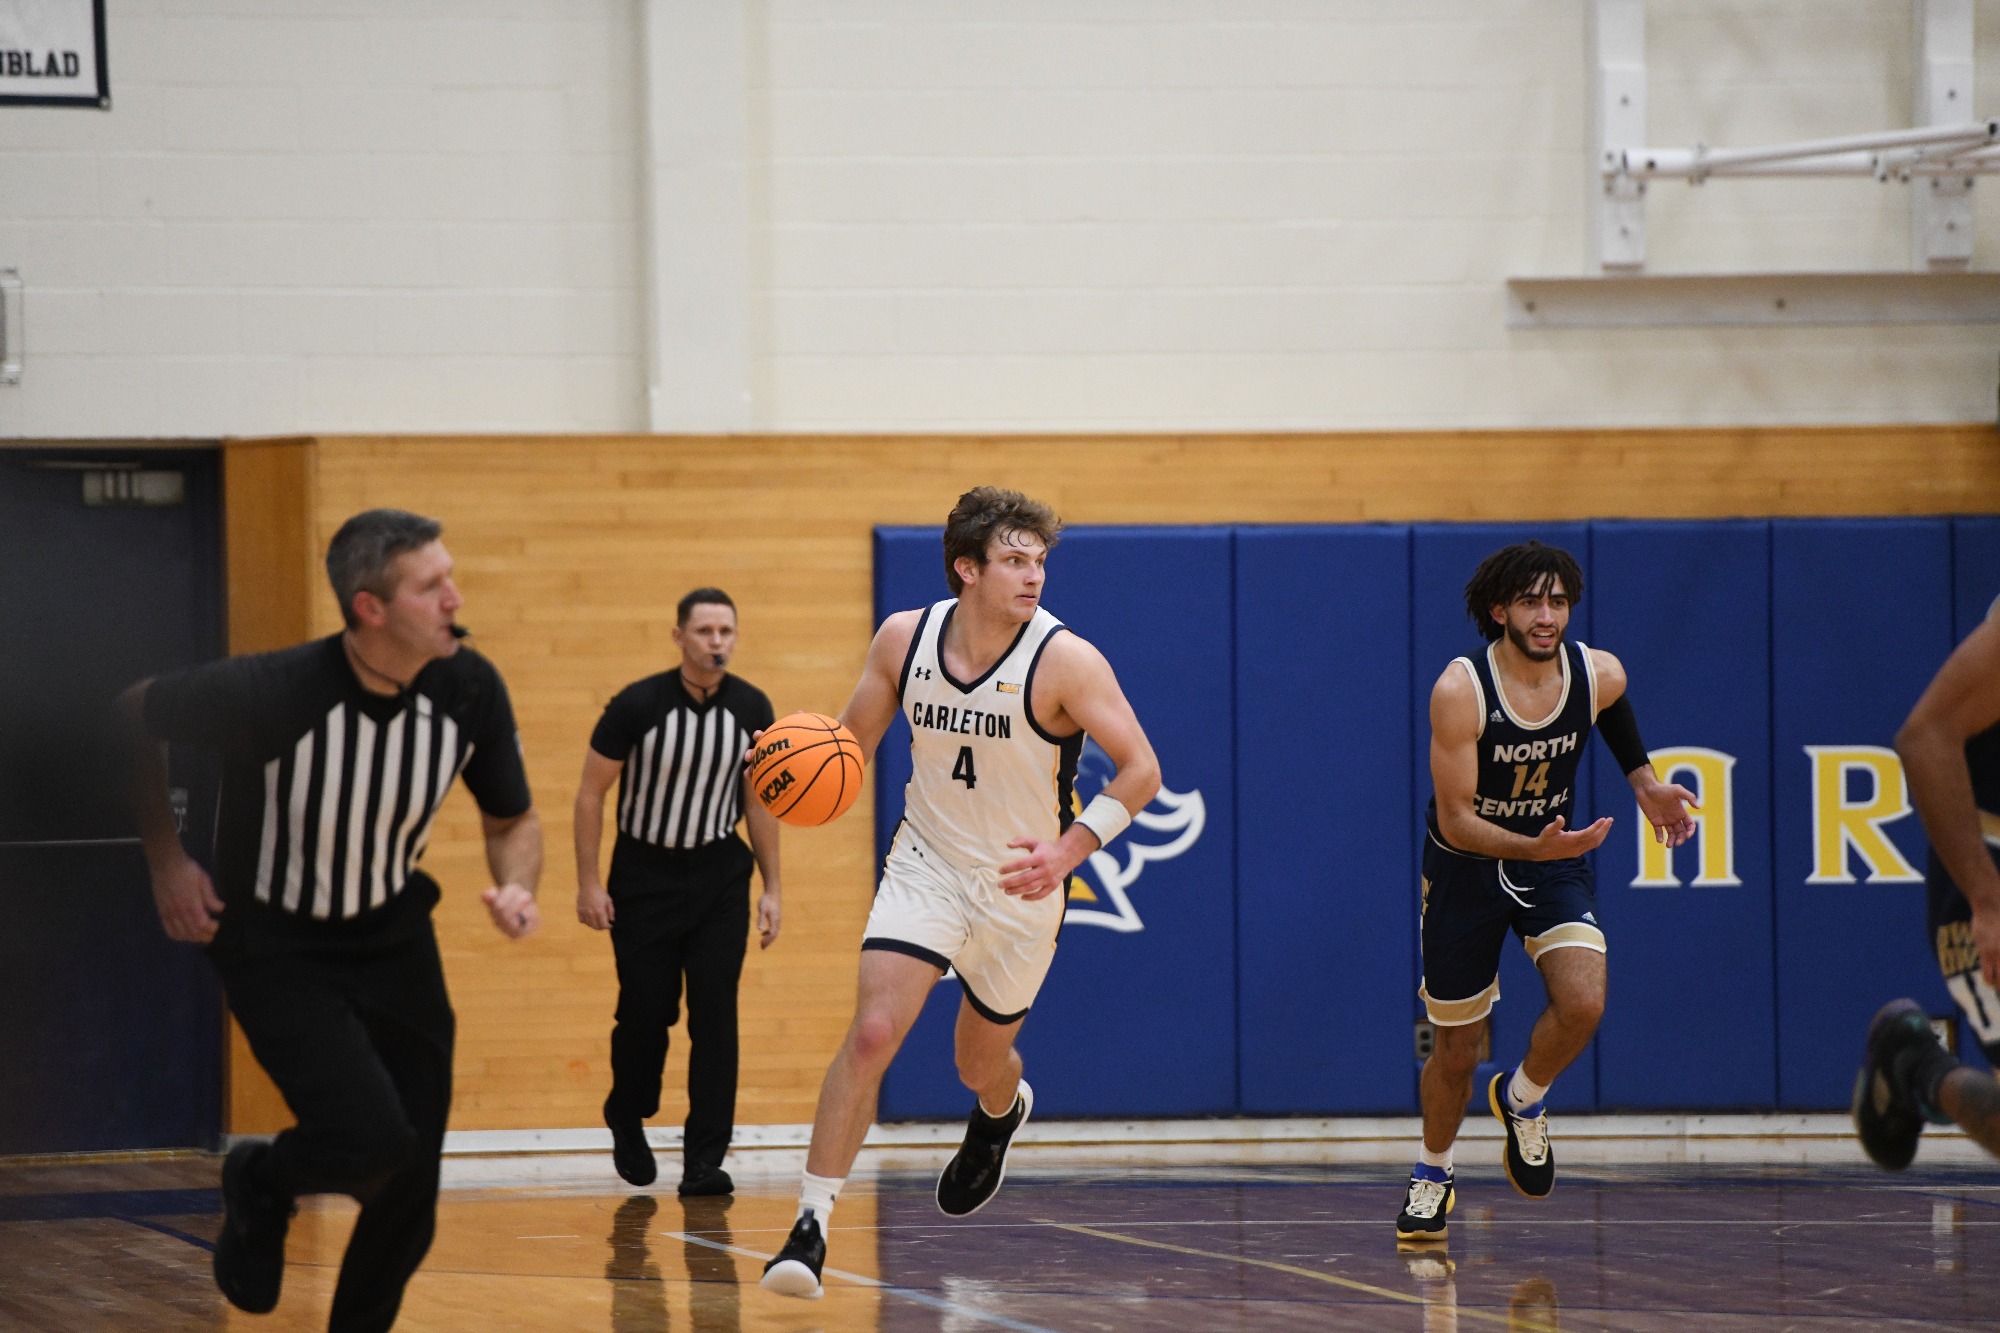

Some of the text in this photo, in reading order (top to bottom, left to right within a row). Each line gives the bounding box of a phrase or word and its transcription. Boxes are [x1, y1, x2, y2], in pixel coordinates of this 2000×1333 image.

[0, 51, 79, 77] BLAD
[913, 702, 1011, 739] CARLETON
[1493, 732, 1577, 763] NORTH
[952, 746, 976, 789] 4
[1510, 762, 1551, 798] 14
[760, 769, 796, 805] NCAA
